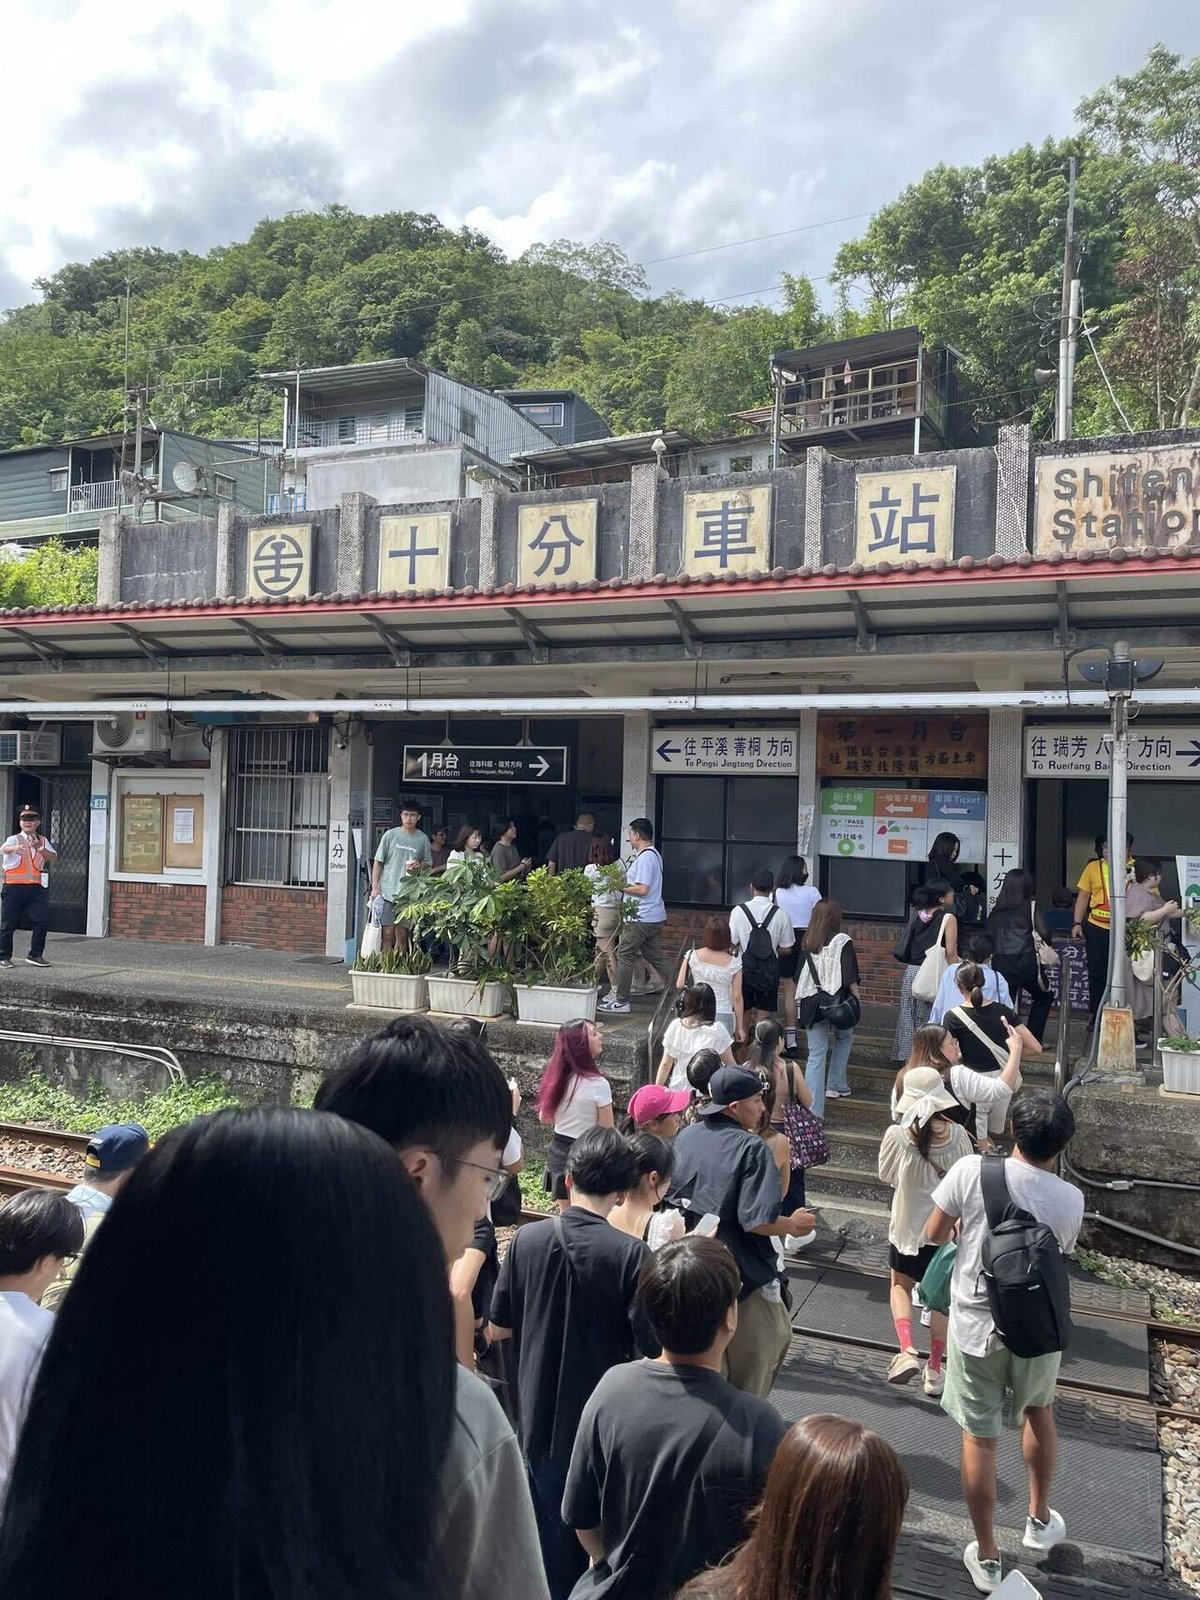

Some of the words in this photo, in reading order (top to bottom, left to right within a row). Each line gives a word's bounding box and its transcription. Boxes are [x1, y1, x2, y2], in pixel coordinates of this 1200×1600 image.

[1053, 464, 1193, 500] Shifen
[685, 758, 694, 767] To
[696, 759, 718, 768] Pingsi
[721, 759, 754, 769] Jingtong
[756, 759, 792, 768] Direction
[1032, 761, 1043, 770] To
[1049, 761, 1091, 771] Rueifang
[1127, 761, 1171, 771] Direction
[429, 769, 460, 777] Platform
[954, 795, 980, 804] Ticket
[332, 824, 345, 858] 十分
[329, 862, 346, 870] Shifen
